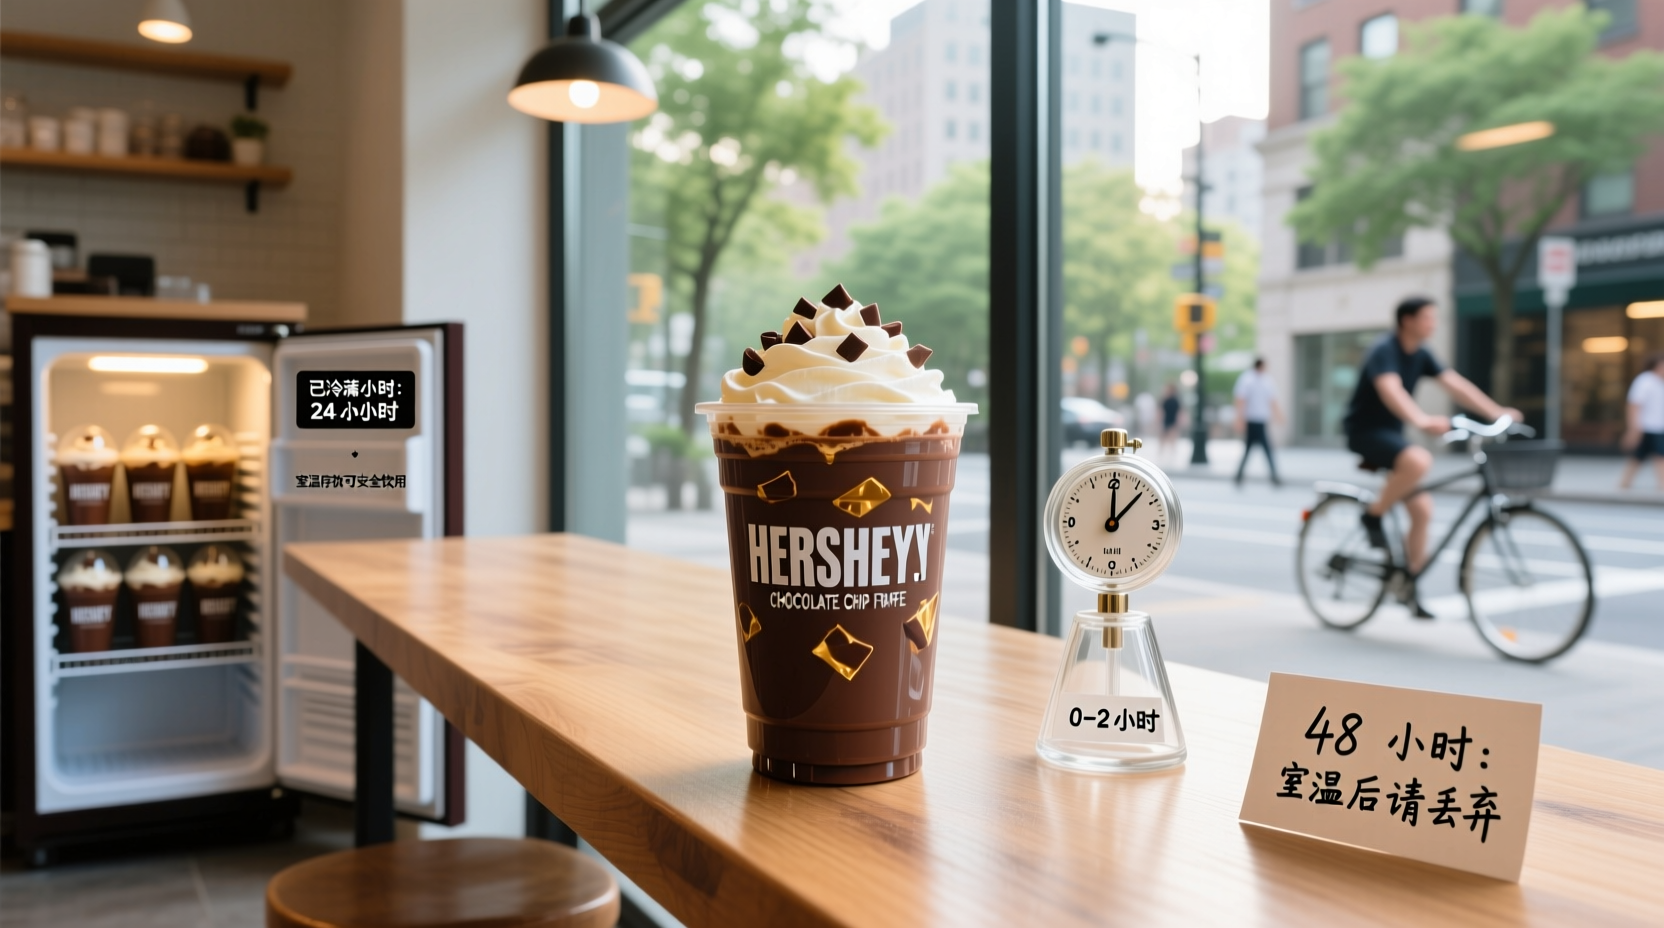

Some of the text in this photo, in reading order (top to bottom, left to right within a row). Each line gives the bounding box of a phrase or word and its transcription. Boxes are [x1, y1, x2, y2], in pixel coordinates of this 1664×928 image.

[310, 400, 399, 422] 24 小小时
[1151, 519, 1160, 531] 3
[770, 591, 840, 610] CHOCOLATE
[1069, 707, 1160, 733] 0-2 小时
[1304, 705, 1490, 772] 48 小时:
[1276, 761, 1502, 843] 室温后请丢弃
